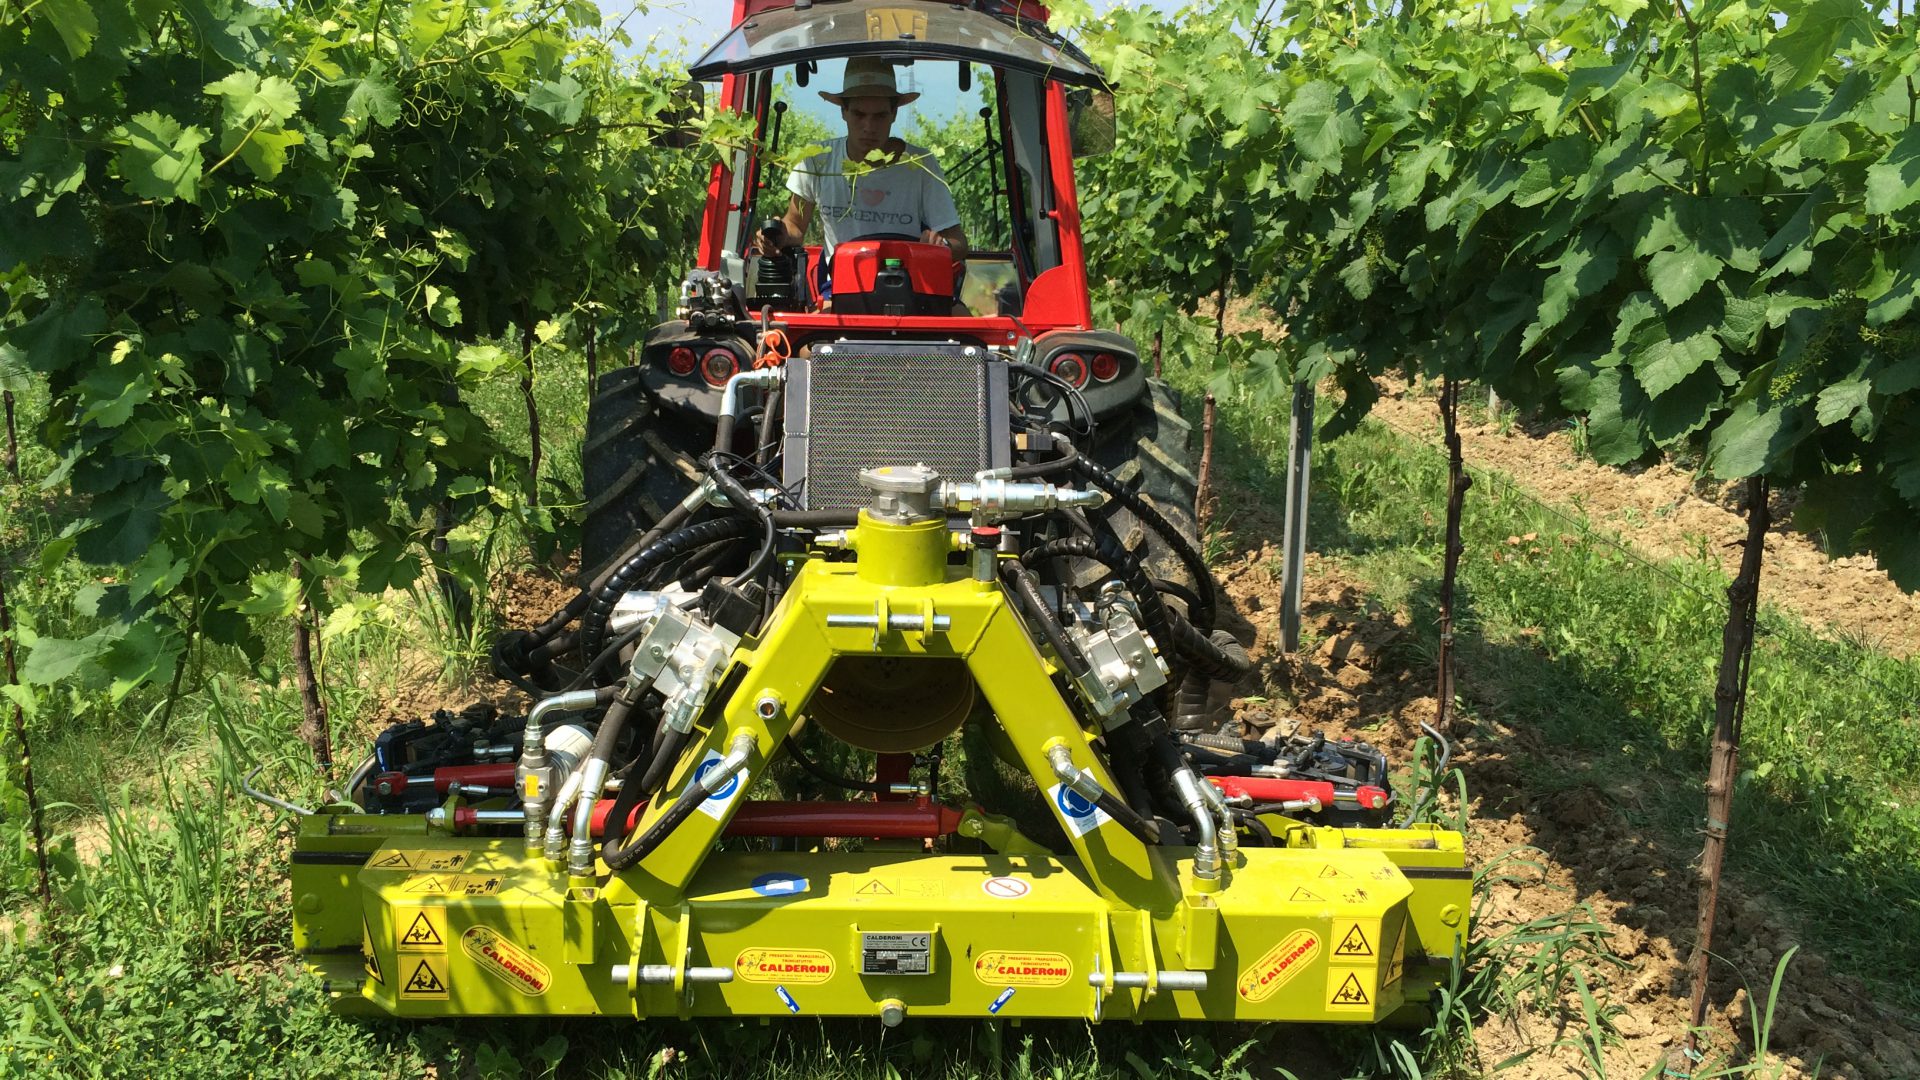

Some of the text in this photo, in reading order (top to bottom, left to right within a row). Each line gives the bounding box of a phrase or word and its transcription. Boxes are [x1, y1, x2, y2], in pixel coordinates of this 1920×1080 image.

[482, 946, 544, 990] CALDERONI
[759, 963, 830, 974] CALDERONI
[997, 966, 1068, 976] CALDERONI
[1260, 937, 1316, 985] CALDERONI
